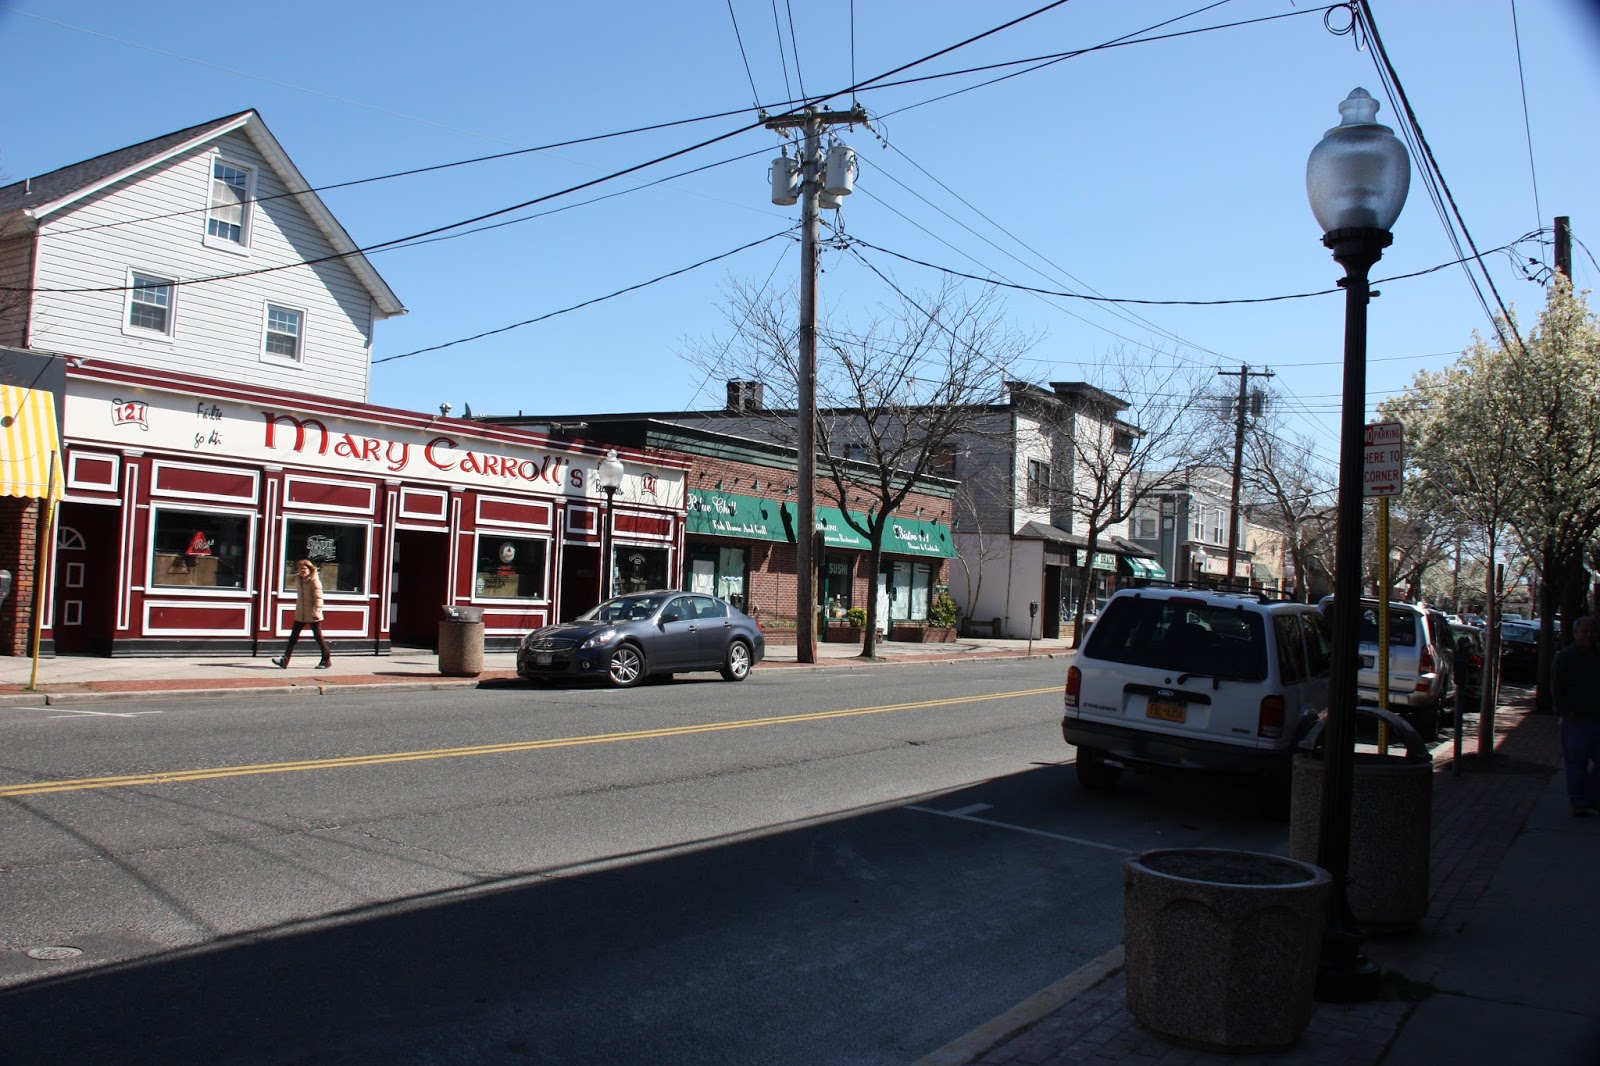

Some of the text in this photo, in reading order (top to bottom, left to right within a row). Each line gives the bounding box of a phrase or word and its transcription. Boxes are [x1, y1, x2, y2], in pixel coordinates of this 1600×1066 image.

[115, 404, 146, 422] 121
[194, 432, 205, 449] go
[1374, 430, 1400, 441] PARKING
[1364, 451, 1400, 464] HERE TO
[1365, 470, 1399, 483] CORNER
[643, 476, 657, 494] 121
[687, 494, 738, 515] Blue Chill
[829, 563, 848, 575] SUSHI
